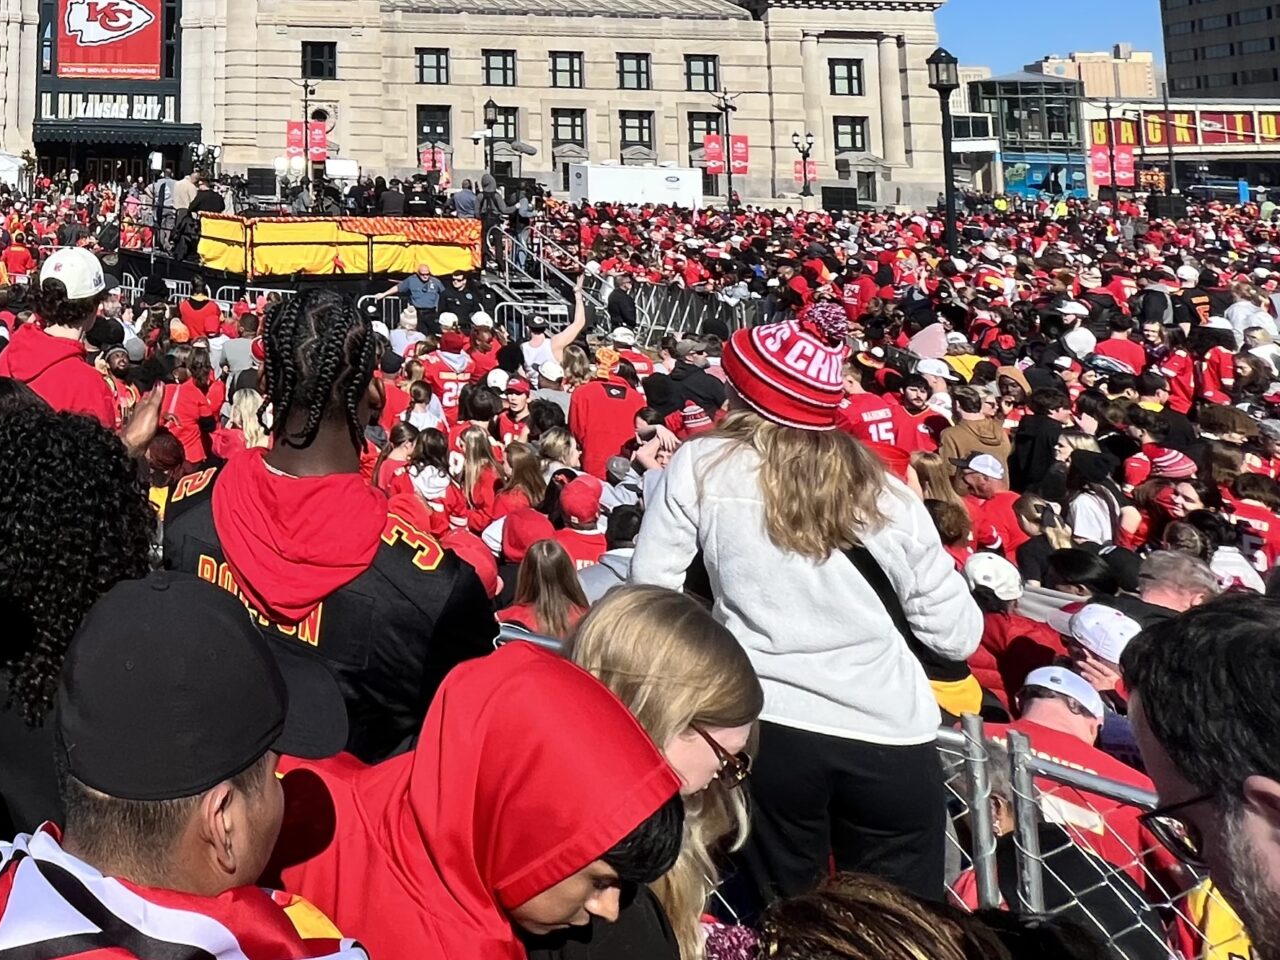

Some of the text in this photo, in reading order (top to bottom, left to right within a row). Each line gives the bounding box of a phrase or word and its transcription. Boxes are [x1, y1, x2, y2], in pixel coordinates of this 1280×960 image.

[86, 2, 132, 31] KC
[76, 102, 128, 118] KANSAS
[1092, 114, 1191, 145] BACK
